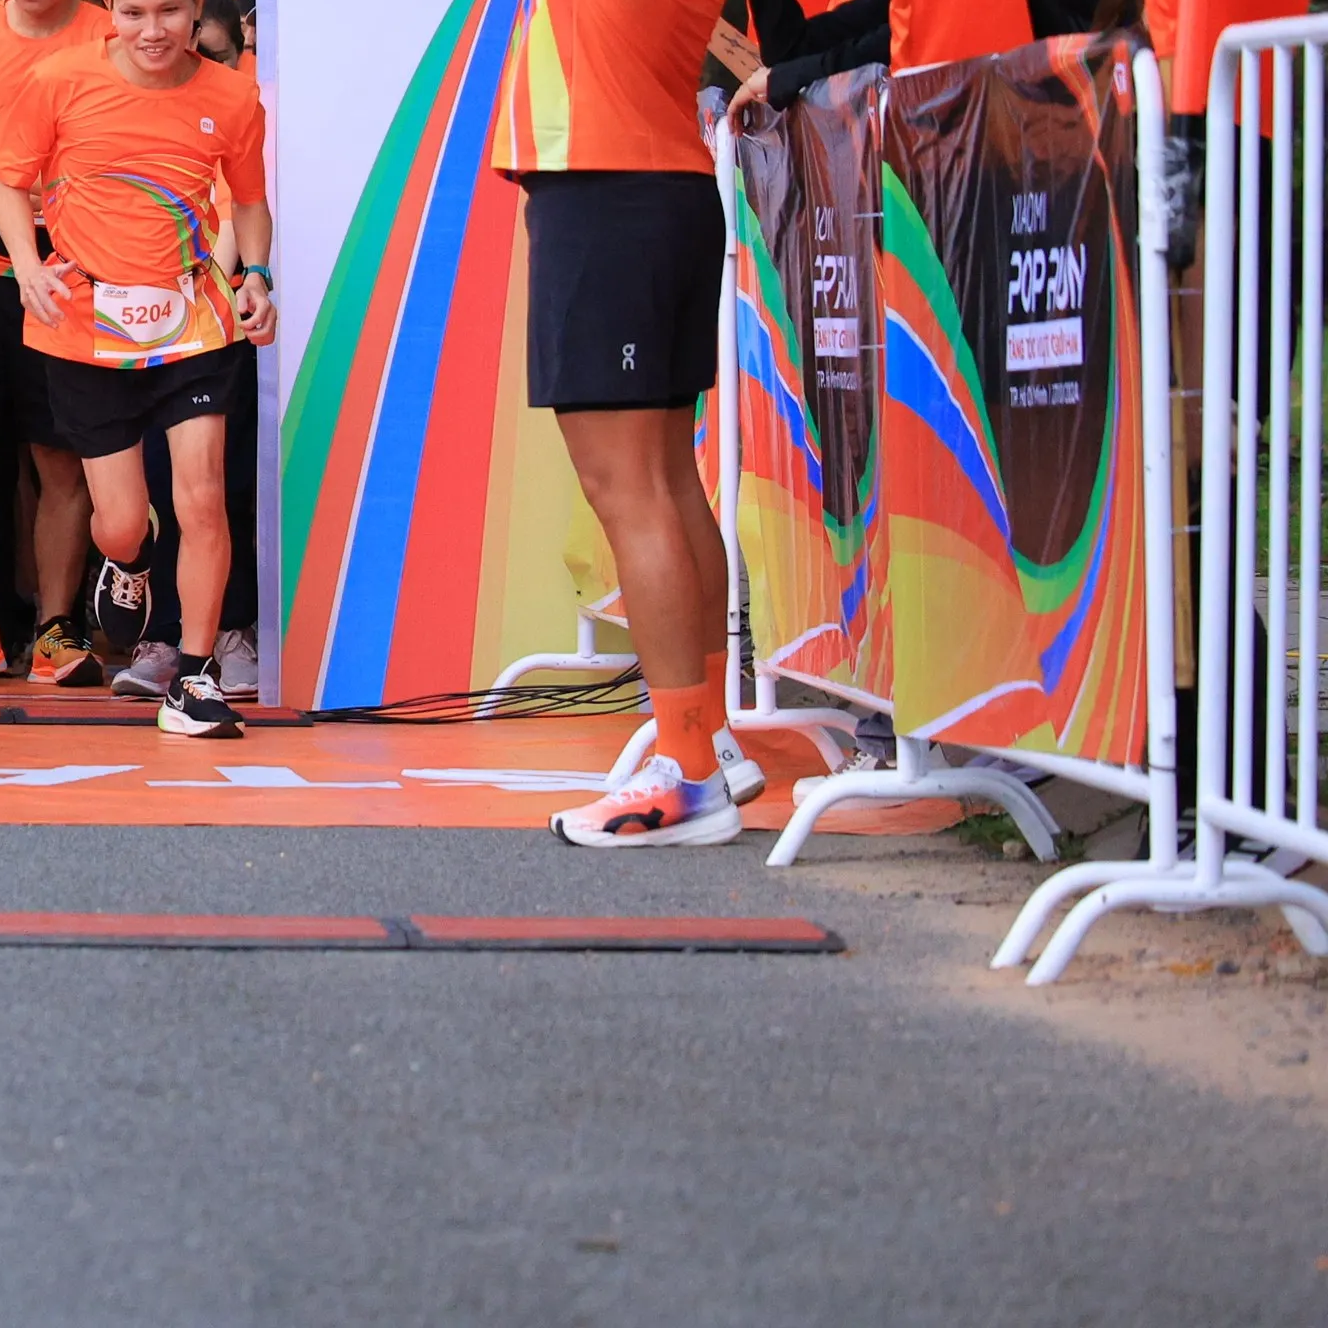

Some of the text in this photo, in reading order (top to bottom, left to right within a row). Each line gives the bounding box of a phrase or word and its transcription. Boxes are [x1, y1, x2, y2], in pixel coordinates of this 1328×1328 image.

[1008, 243, 1086, 315] POP RUN
[121, 300, 172, 325] 5204
